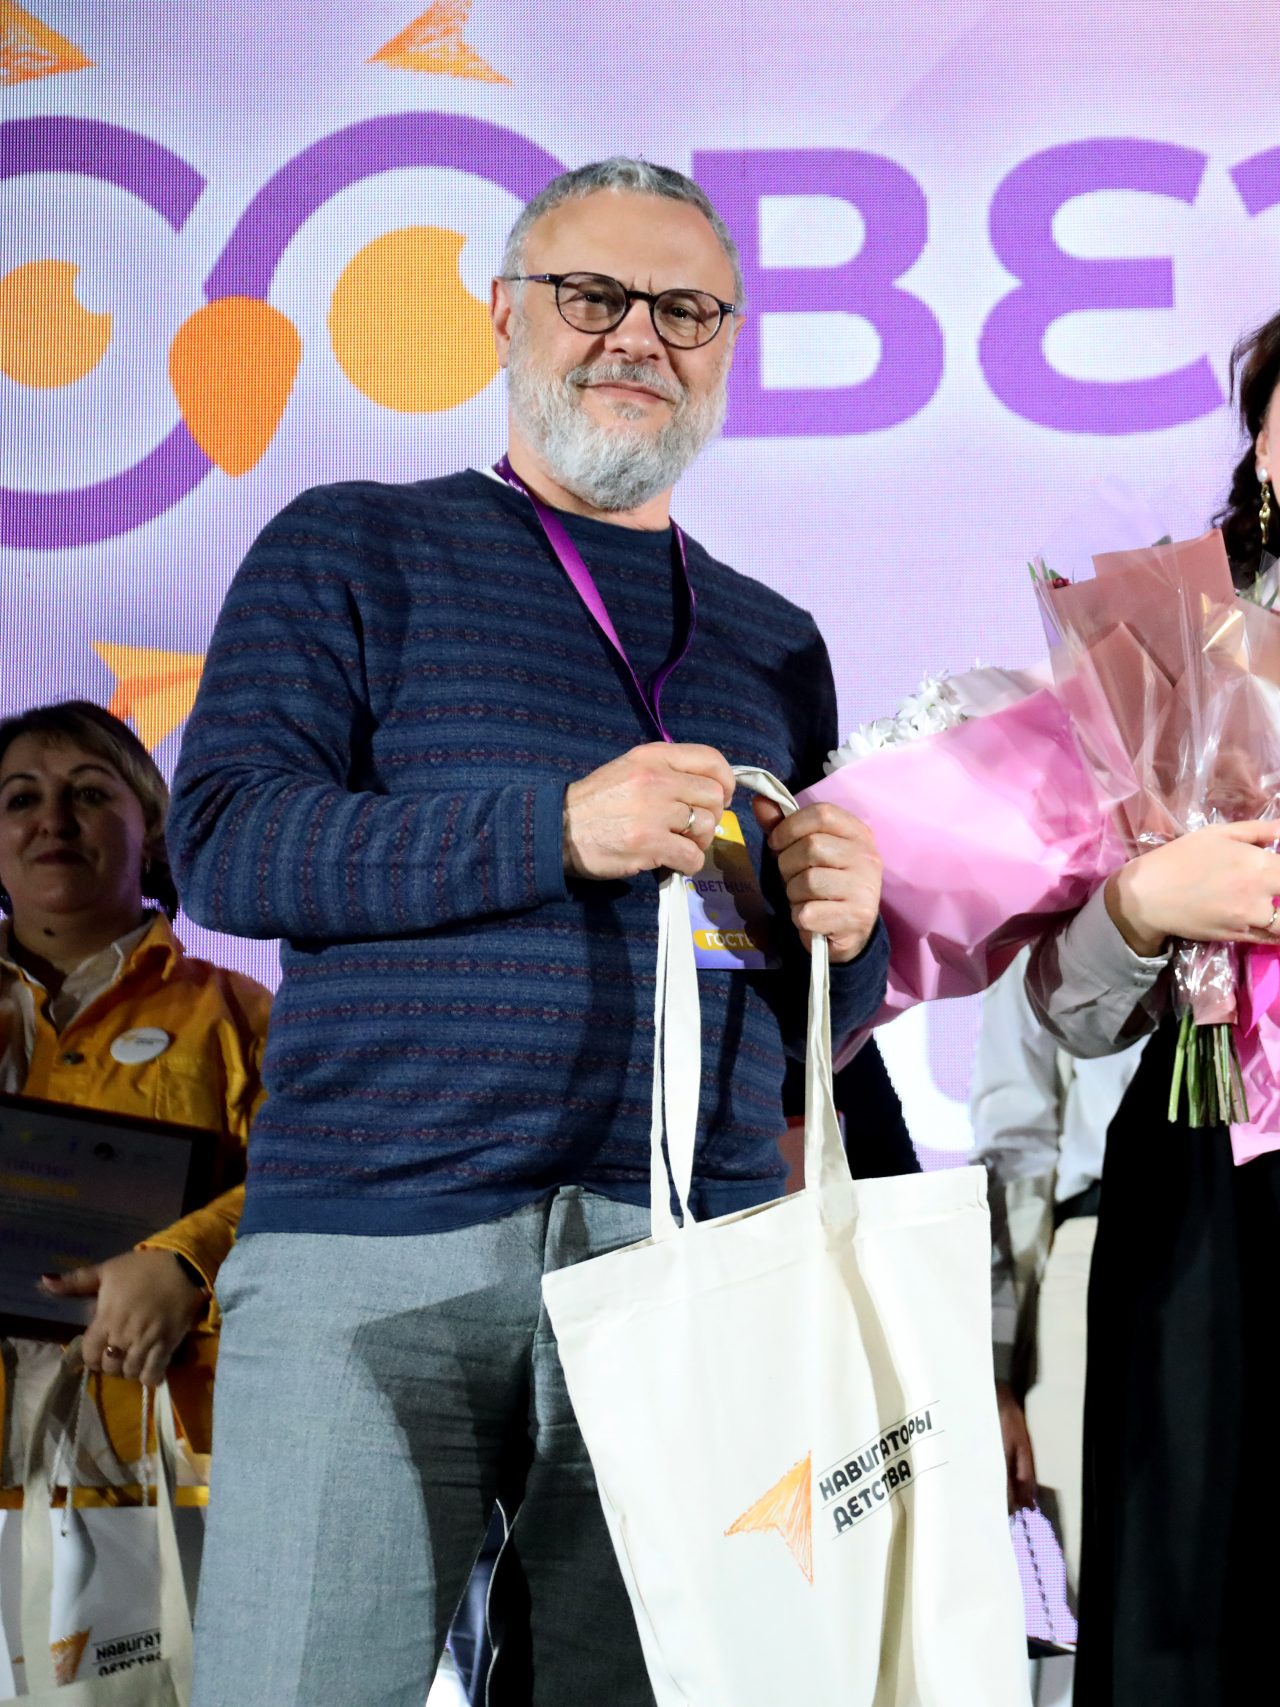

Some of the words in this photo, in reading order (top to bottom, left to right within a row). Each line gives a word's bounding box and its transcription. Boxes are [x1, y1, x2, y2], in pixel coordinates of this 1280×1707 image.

[818, 1410, 933, 1501] НАВИГАТОРЫ
[832, 1459, 912, 1534] ДЕТСТВА
[95, 1632, 161, 1660] НАВИГАТ
